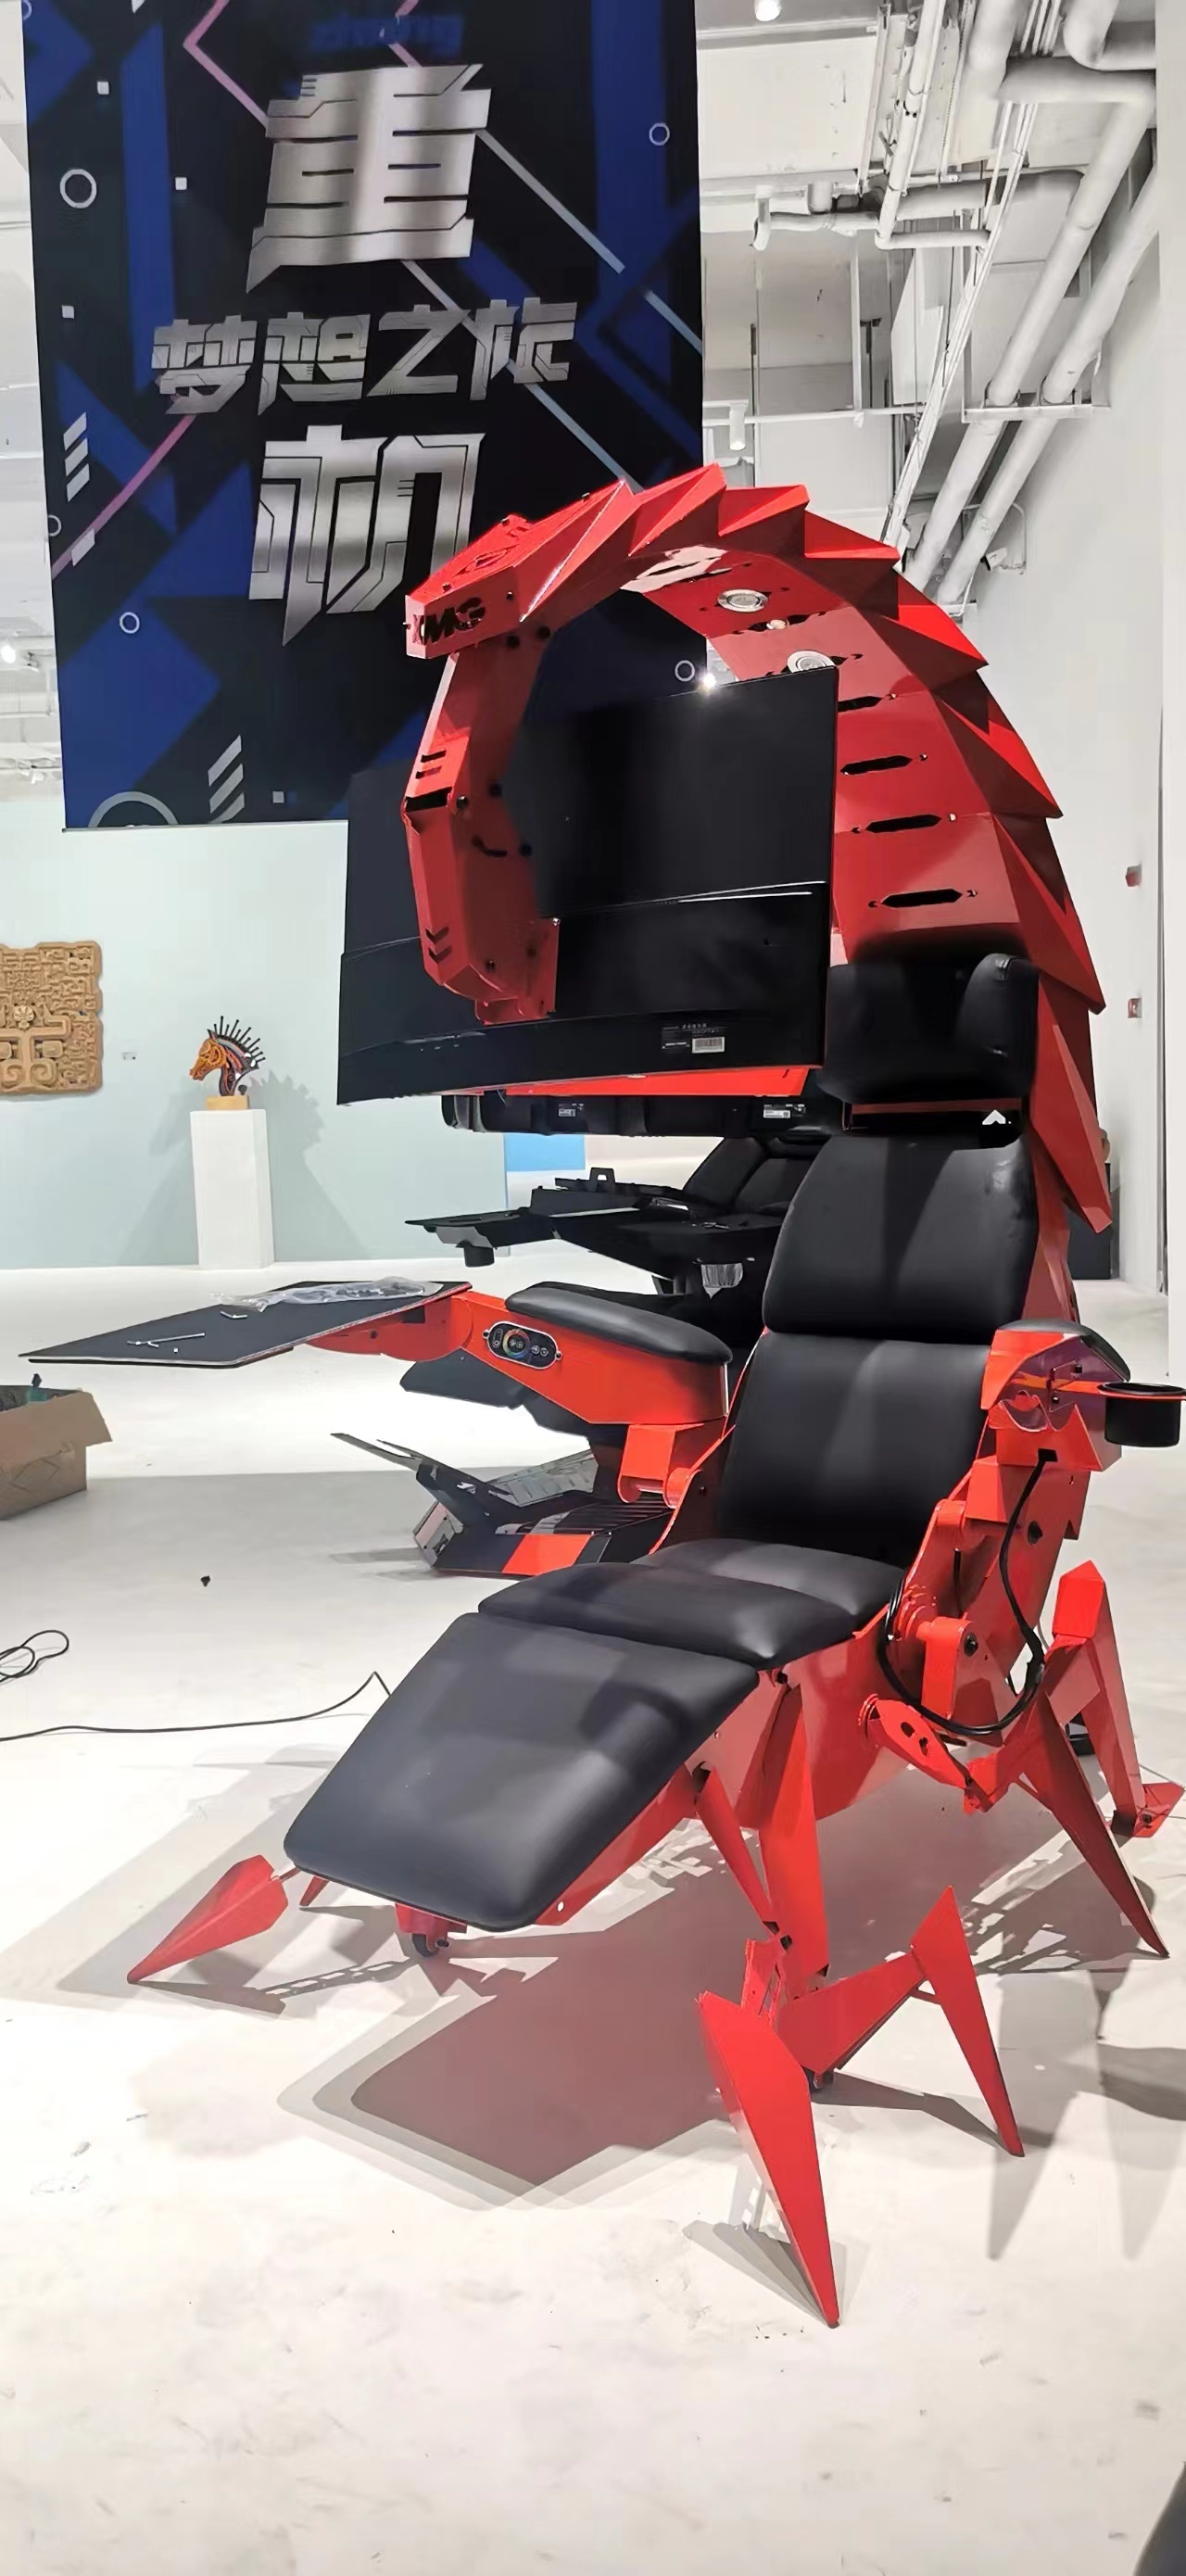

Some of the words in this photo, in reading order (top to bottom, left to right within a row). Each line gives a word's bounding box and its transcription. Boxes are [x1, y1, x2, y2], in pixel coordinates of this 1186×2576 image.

[246, 63, 491, 293] 重
[151, 297, 577, 415] 梦想之旅
[248, 424, 486, 646] 机
